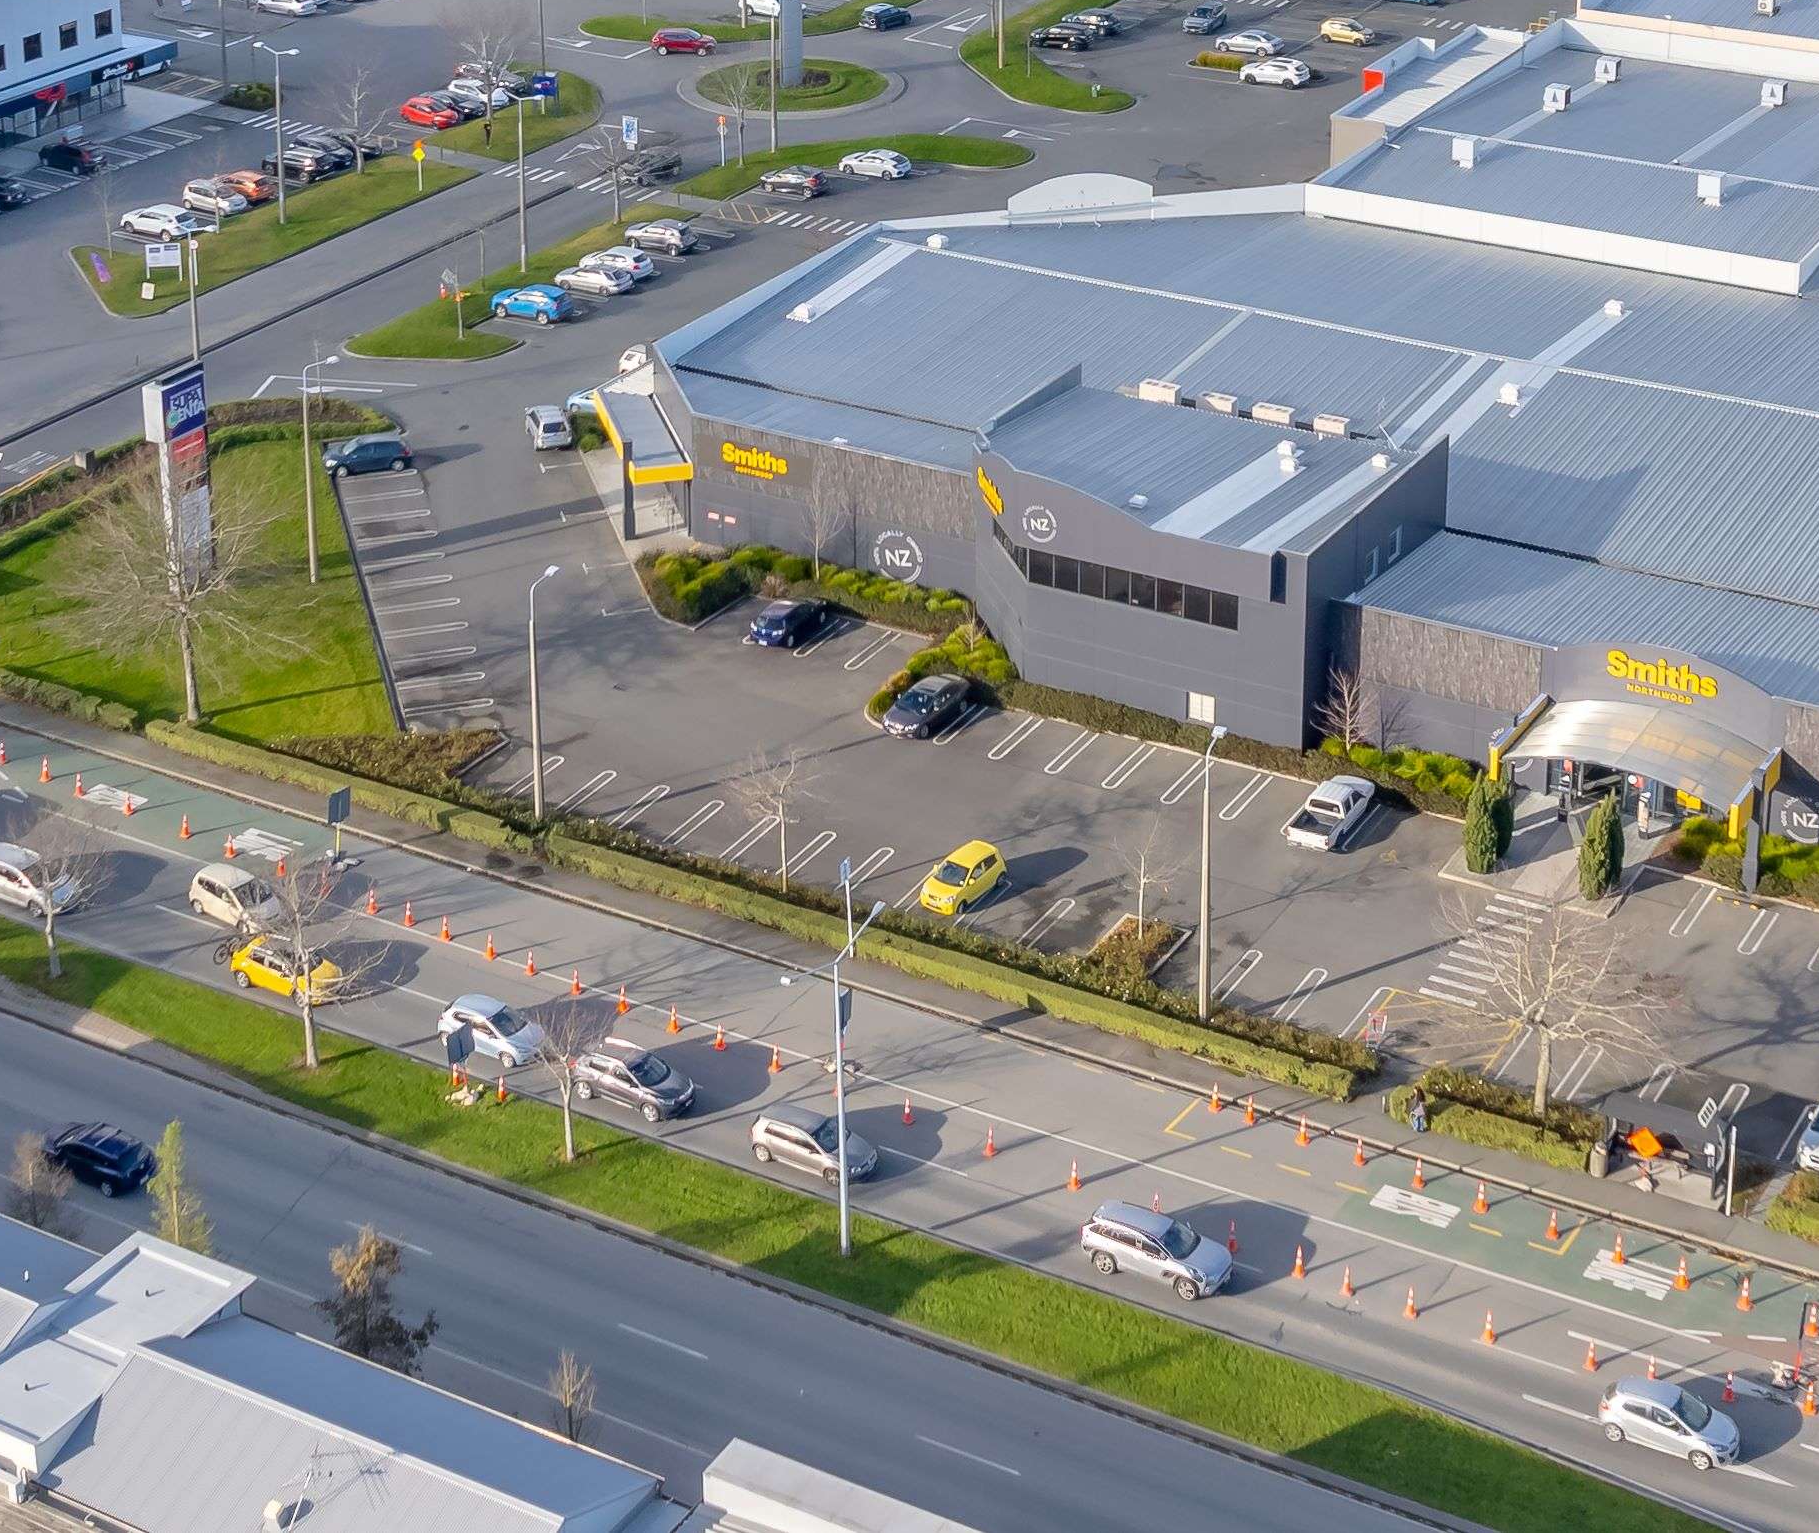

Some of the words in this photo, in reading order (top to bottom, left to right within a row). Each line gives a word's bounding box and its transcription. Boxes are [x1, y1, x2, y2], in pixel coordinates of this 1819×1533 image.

[722, 442, 788, 475] Smiths
[1030, 518, 1050, 532] NZ
[884, 548, 913, 567] NZ
[1606, 649, 1718, 698] Smiths
[1626, 683, 1694, 705] NORTHWOOD
[1792, 812, 1819, 829] NZ
